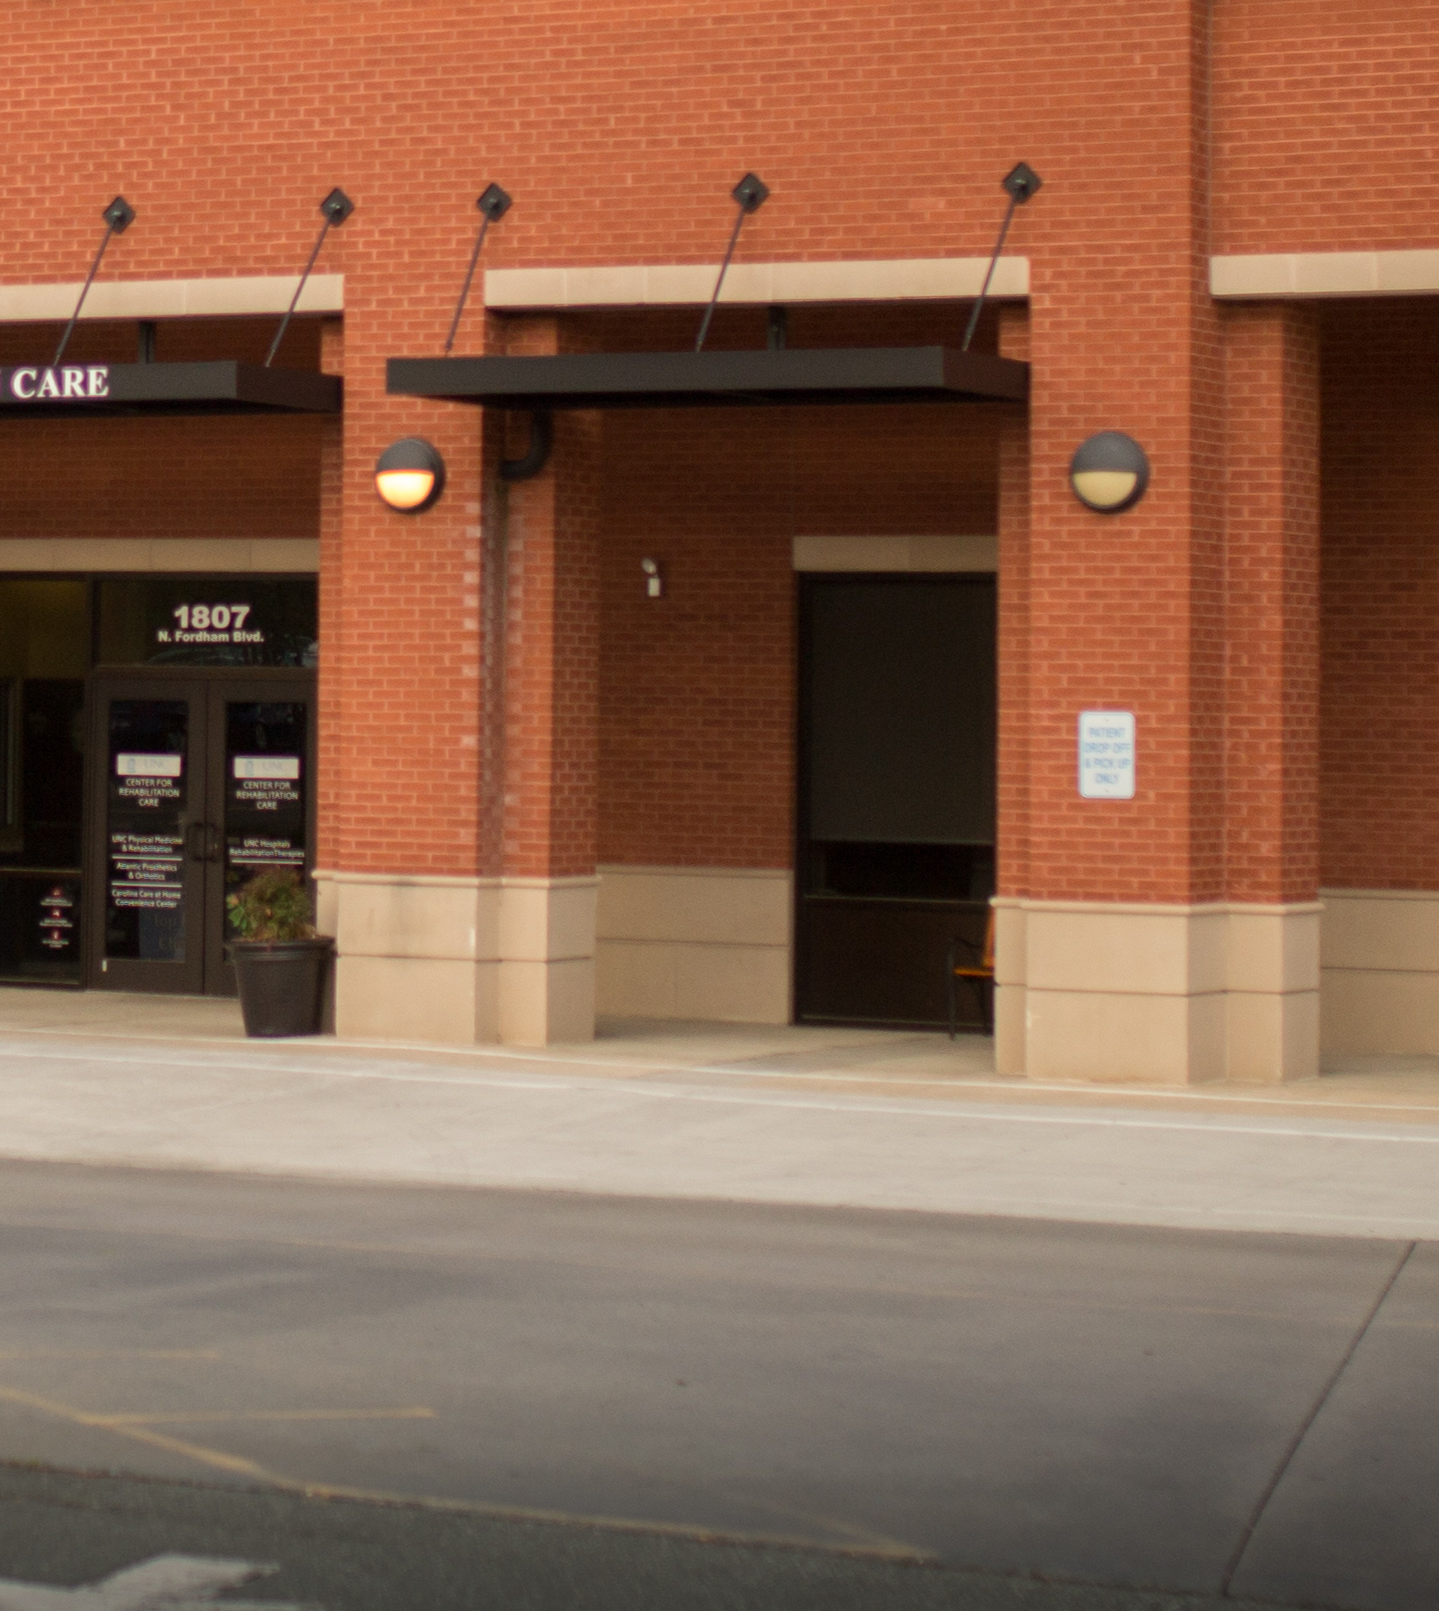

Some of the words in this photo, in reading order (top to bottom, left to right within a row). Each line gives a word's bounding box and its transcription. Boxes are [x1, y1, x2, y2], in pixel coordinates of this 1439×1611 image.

[12, 367, 108, 398] CARE
[173, 605, 250, 629] 1807
[158, 631, 172, 642] N.
[175, 630, 229, 642] Fordham
[233, 630, 264, 642] Blvd.
[1088, 727, 1126, 738] PATIENT
[1084, 742, 1111, 753] DROP
[1112, 742, 1132, 753] OFF
[1094, 757, 1113, 768] PICK
[1118, 758, 1132, 769] UP
[125, 778, 155, 787] CENTER
[156, 778, 172, 787] FOR
[1095, 773, 1119, 784] ONLY
[243, 781, 273, 790] CENTER
[274, 781, 291, 790] FOR
[119, 788, 180, 797] REHABILITATION
[236, 791, 299, 800] REHABILITATION
[138, 798, 159, 807] CARE
[256, 801, 277, 810] CARE
